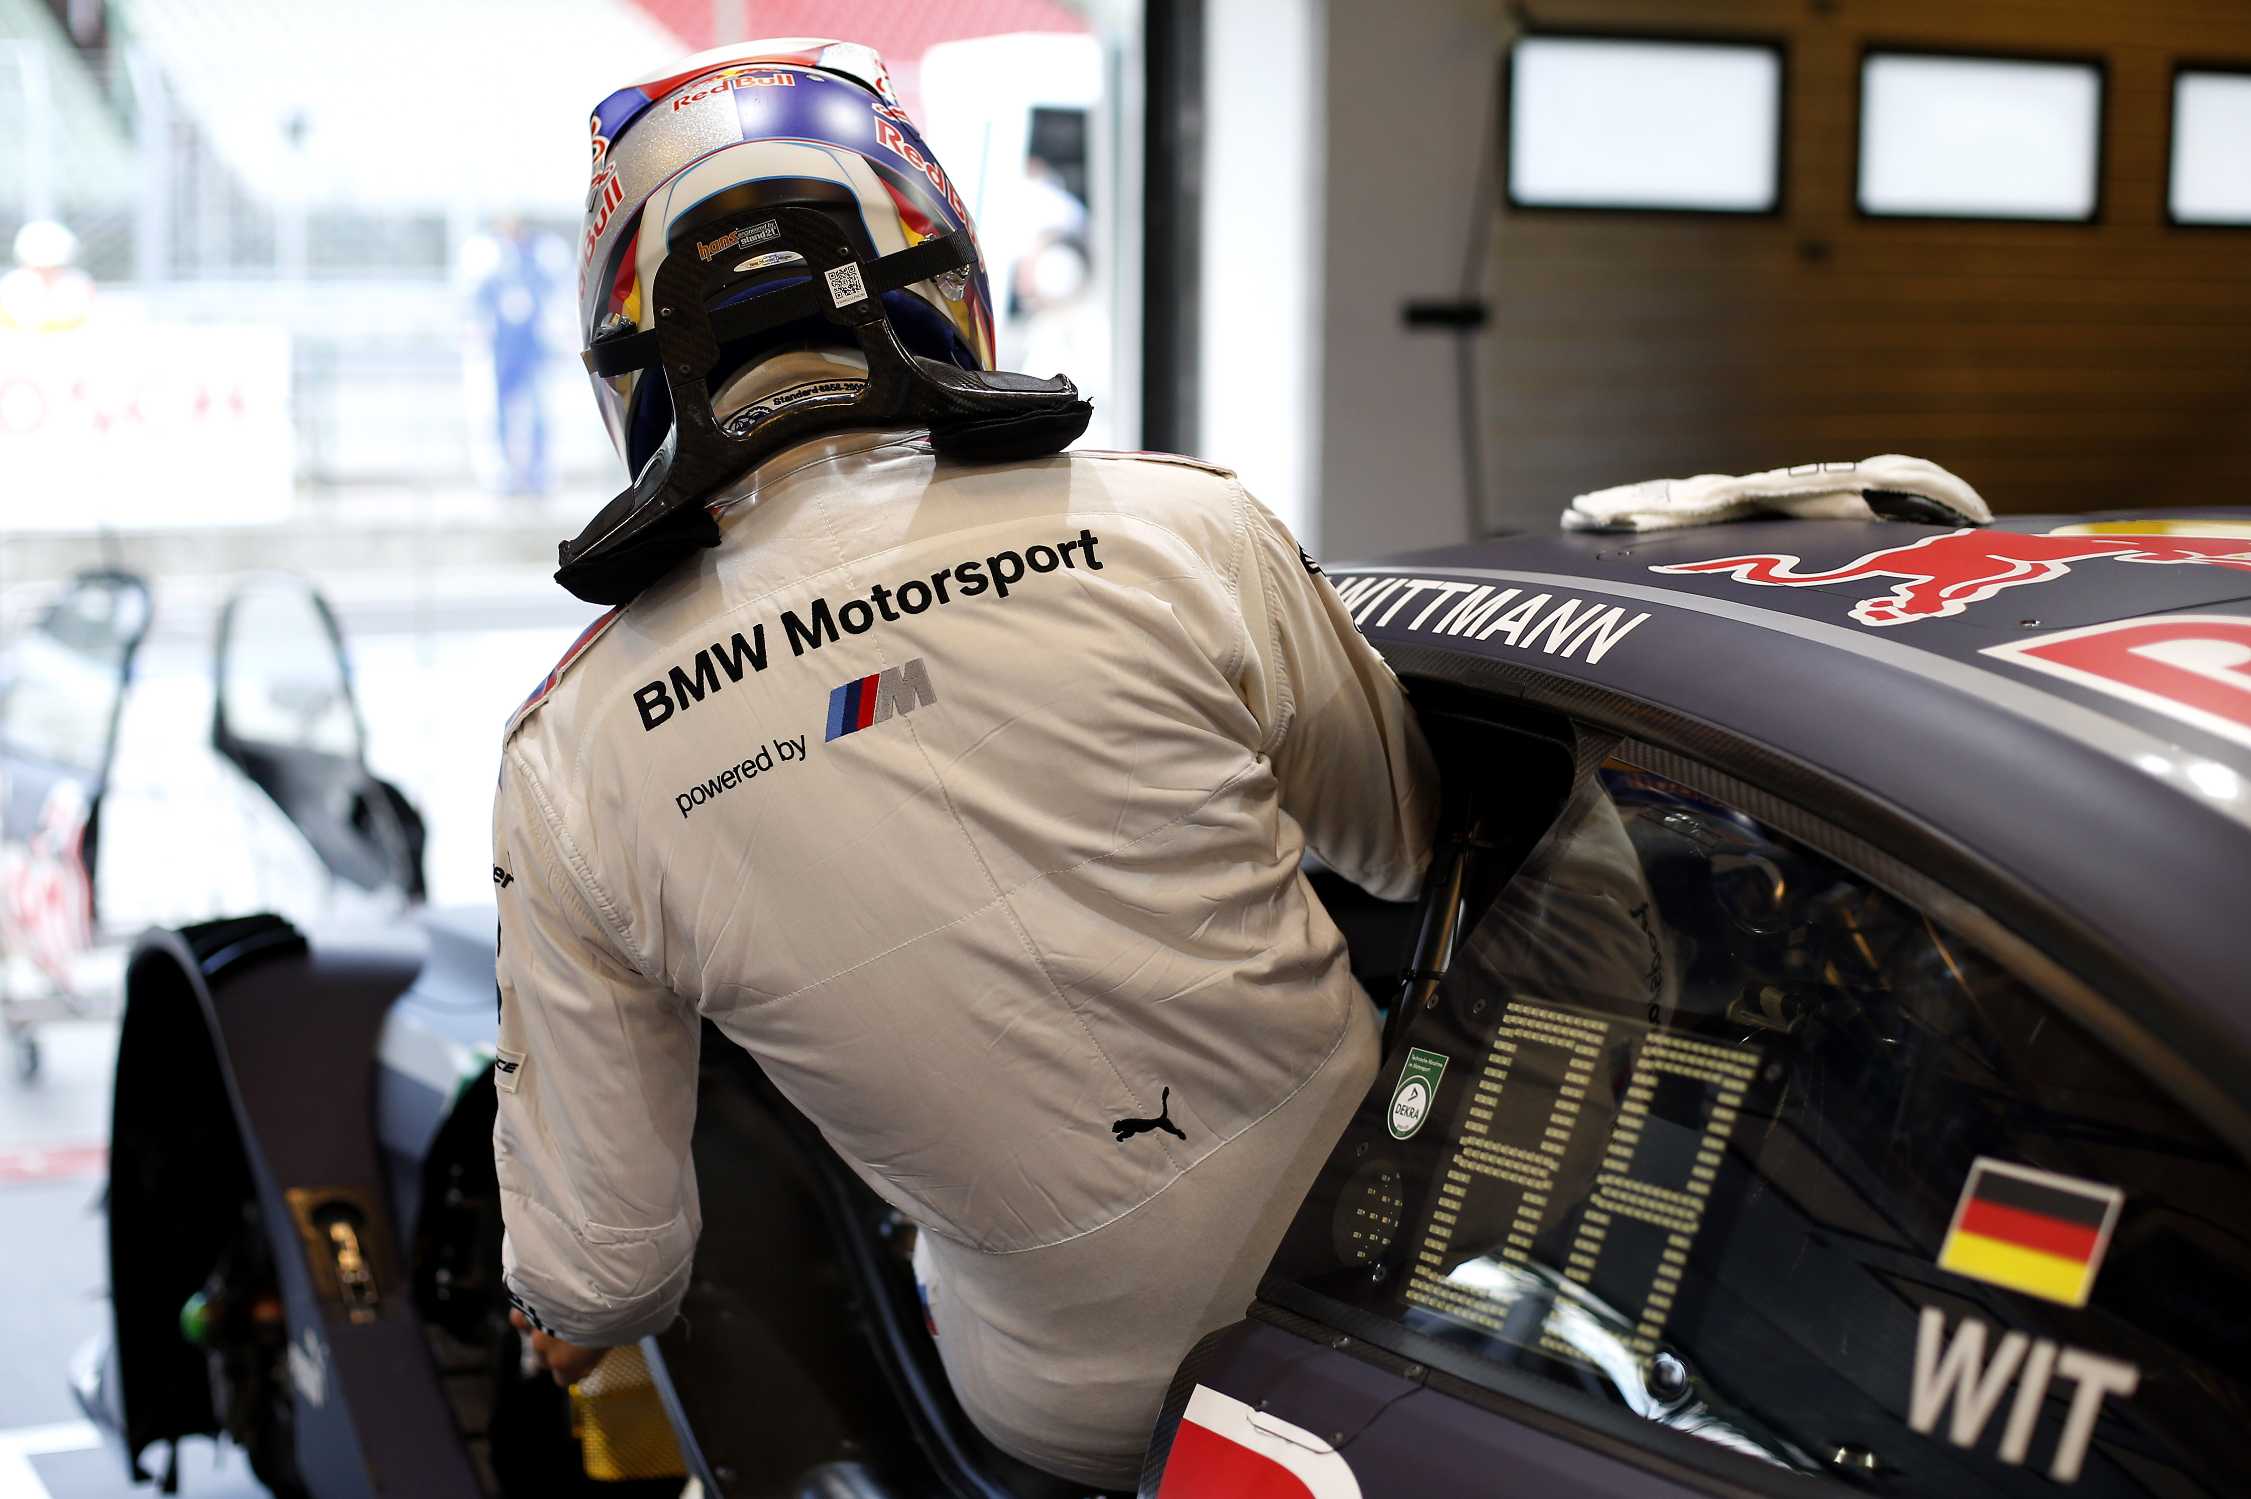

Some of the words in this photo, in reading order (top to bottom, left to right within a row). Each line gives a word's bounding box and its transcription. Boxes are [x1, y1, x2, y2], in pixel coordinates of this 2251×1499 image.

[673, 80, 729, 112] Red
[734, 74, 795, 88] Bull
[876, 116, 946, 196] Red
[584, 173, 624, 266] Bull
[697, 230, 739, 262] hans
[773, 386, 818, 406] Standard
[633, 623, 768, 731] BMW
[780, 529, 1103, 656] Motorsport
[675, 746, 774, 817] powered
[774, 735, 807, 763] by
[1394, 1103, 1420, 1121] DEKRA
[1908, 1305, 2141, 1484] WIT
